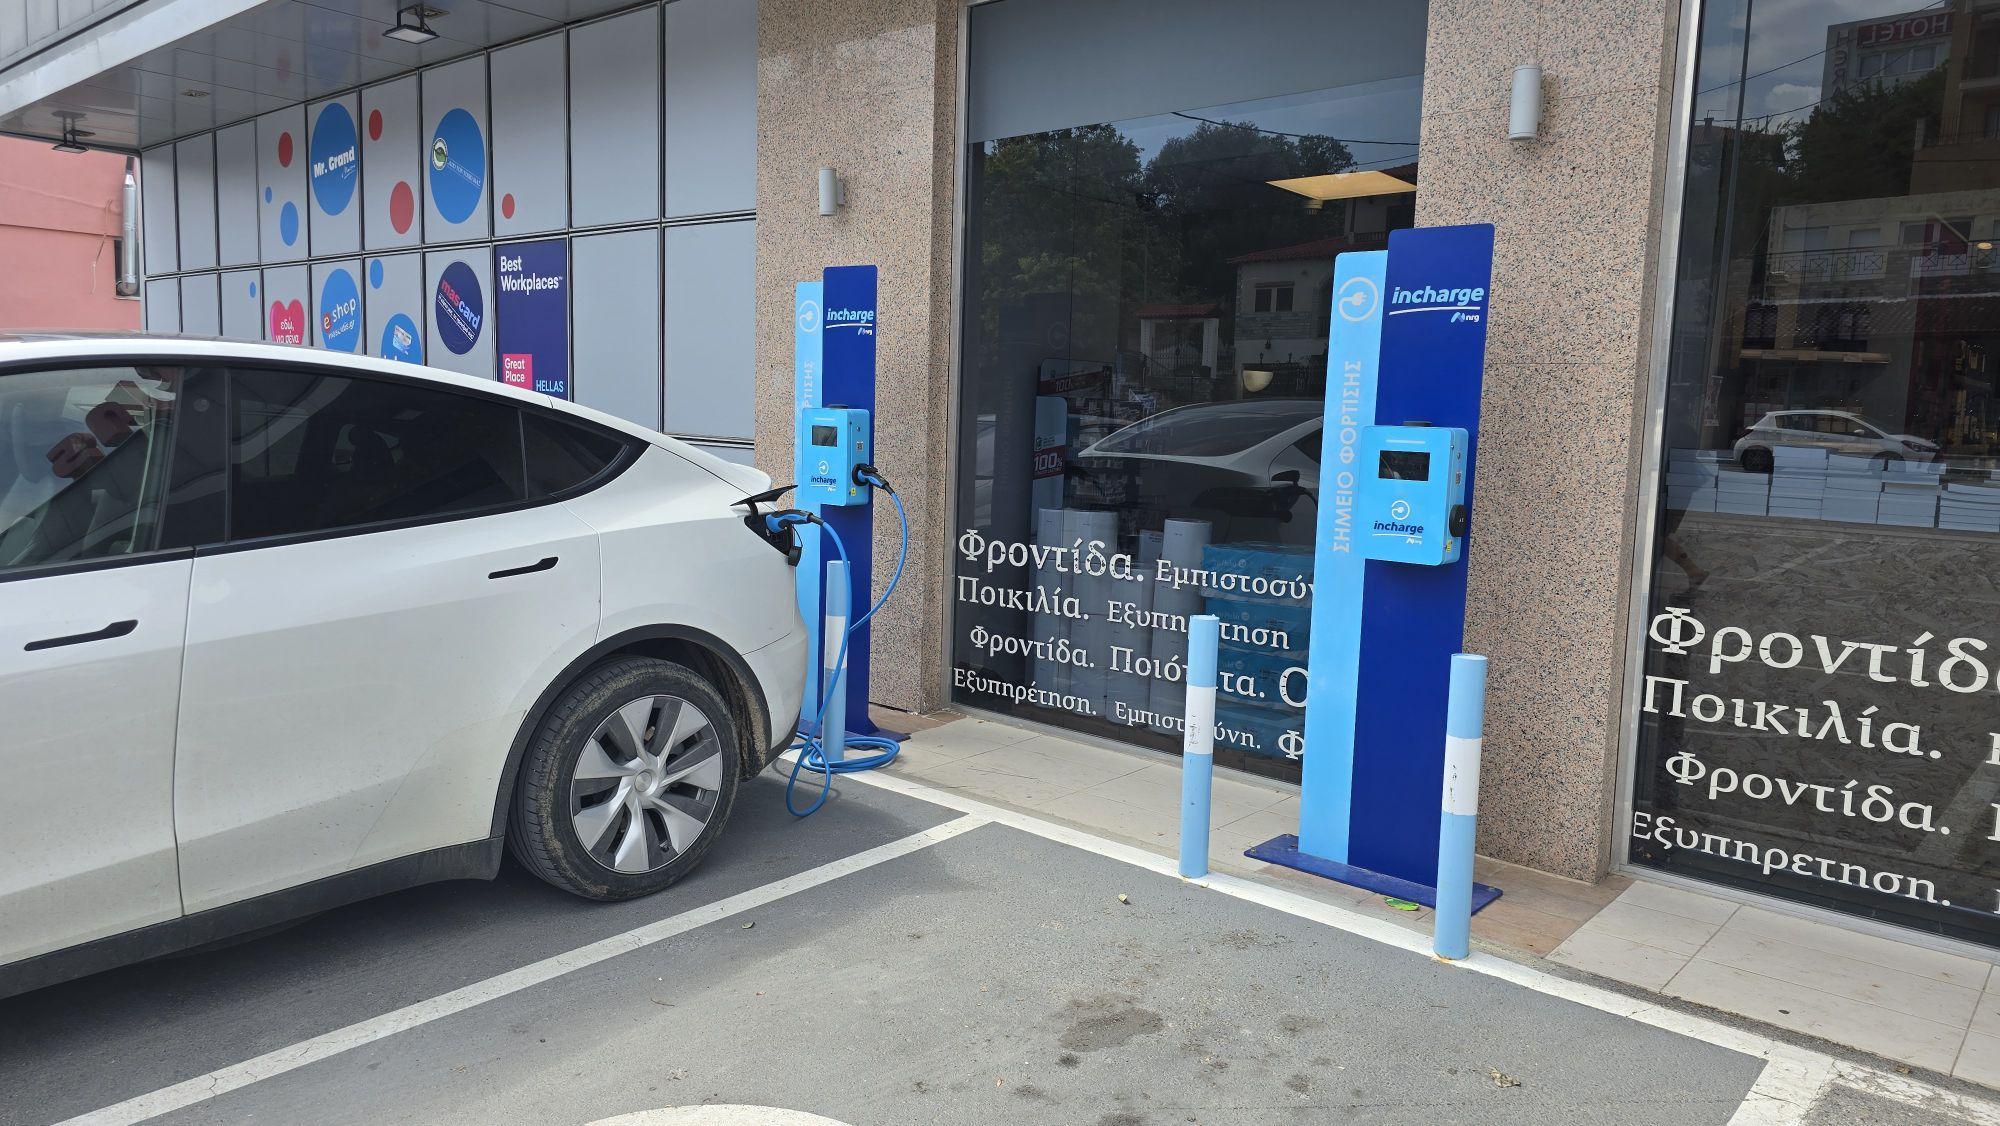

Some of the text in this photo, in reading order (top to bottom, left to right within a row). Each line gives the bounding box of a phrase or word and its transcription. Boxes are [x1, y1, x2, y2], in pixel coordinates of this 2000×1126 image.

[313, 162, 328, 178] Mr.
[328, 145, 355, 171] Grand
[500, 255, 522, 272] Best
[441, 280, 480, 330] mascard
[827, 308, 874, 324] incharge
[1392, 286, 1484, 307] incharge
[504, 358, 525, 370] Great
[505, 370, 525, 383] Place
[535, 379, 564, 393] HELLAS
[810, 475, 837, 486] incharge
[1333, 360, 1362, 554] ΣΗΜΕΙΟ ΦΟΡΤΙΣΗΣ
[1373, 520, 1424, 535] incharge
[959, 529, 1144, 582] Φροντίδα.
[957, 575, 1289, 650] Ποικιλία. Εξυπητηση
[970, 625, 1095, 668] Φροντίδα.
[1109, 646, 1265, 698] Ποιότα.
[1649, 606, 2000, 693] Φροντίδ
[953, 668, 1097, 716] Εξυπηρέτηση.
[1115, 701, 1261, 749] Εμπιστύνη.
[1643, 675, 1942, 759] Ποικιλία.
[1665, 751, 1950, 835] Φροντίδα.
[1632, 811, 1951, 907] Εξυπηρετηση.
